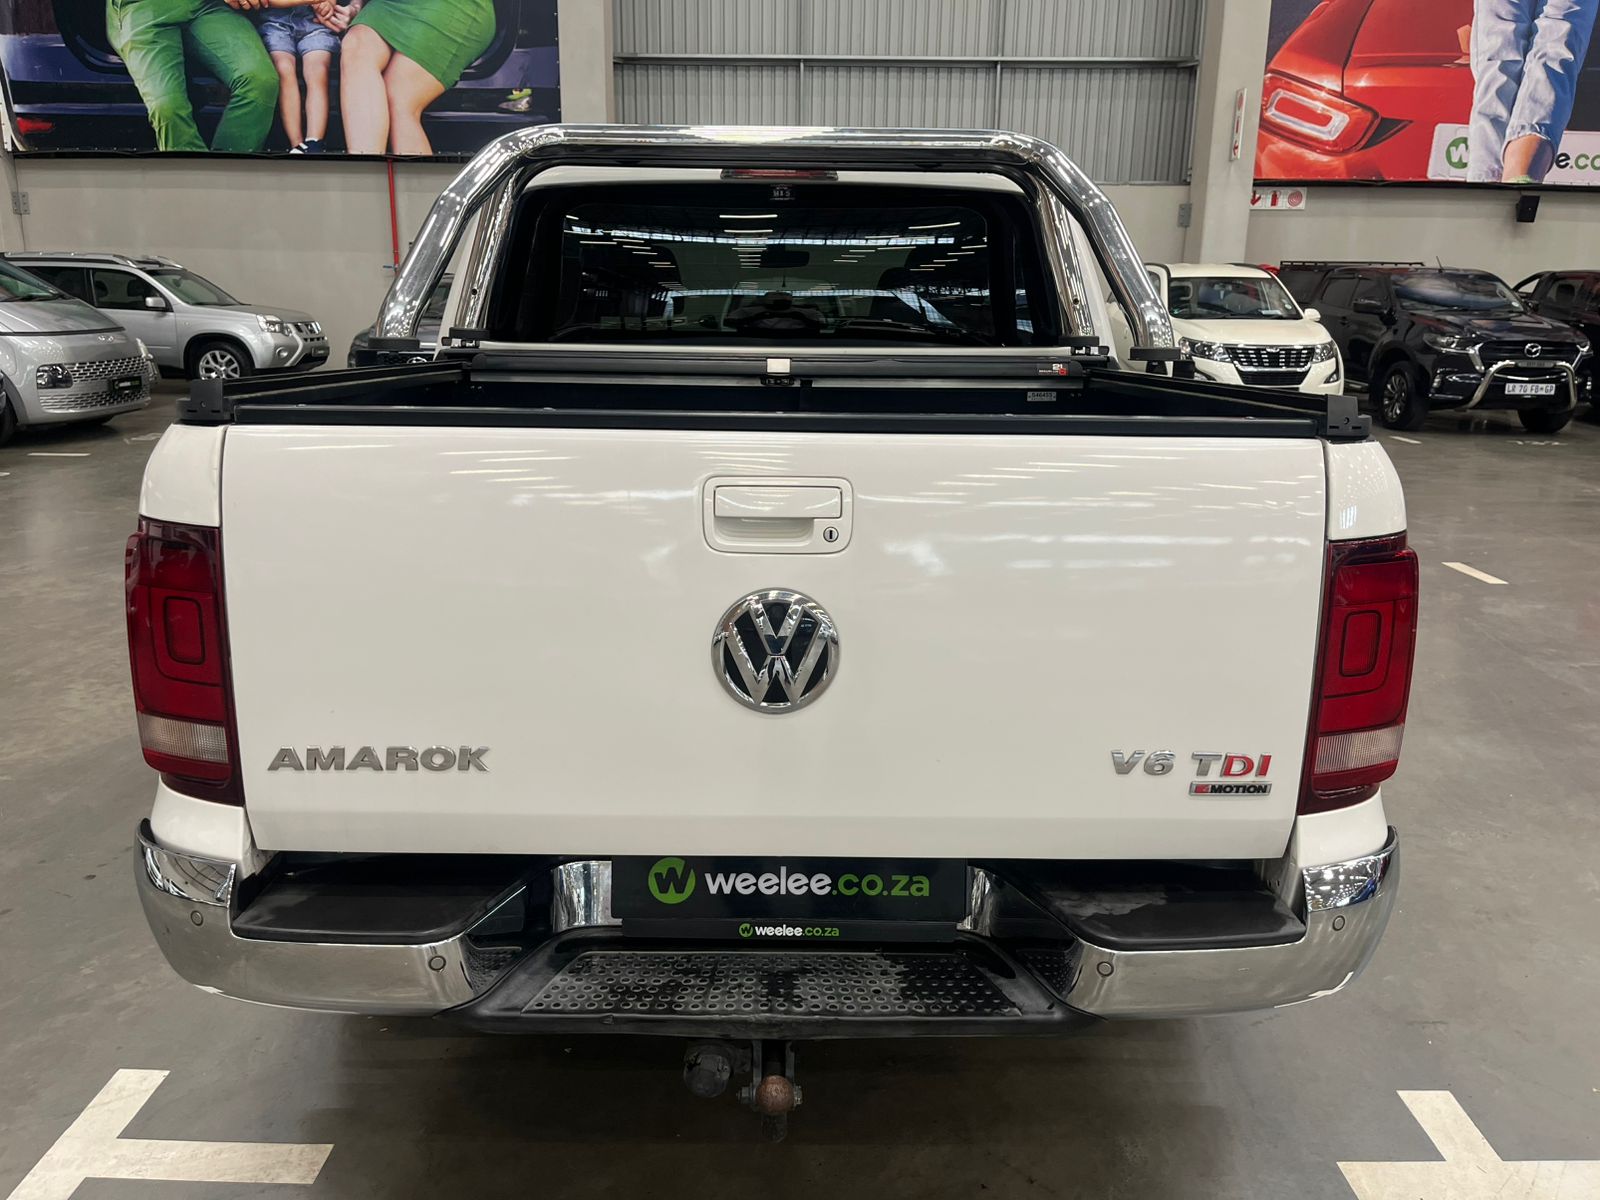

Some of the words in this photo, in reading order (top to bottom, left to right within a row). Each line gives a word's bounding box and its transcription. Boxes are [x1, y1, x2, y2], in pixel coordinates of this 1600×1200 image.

[1506, 384, 1516, 393] LR
[1544, 384, 1554, 394] GP
[267, 745, 491, 772] AMAROK
[1111, 750, 1176, 776] V6
[1191, 752, 1272, 777] TDI
[704, 866, 930, 896] weelee.co.za
[755, 924, 840, 937] weelee.co.za
